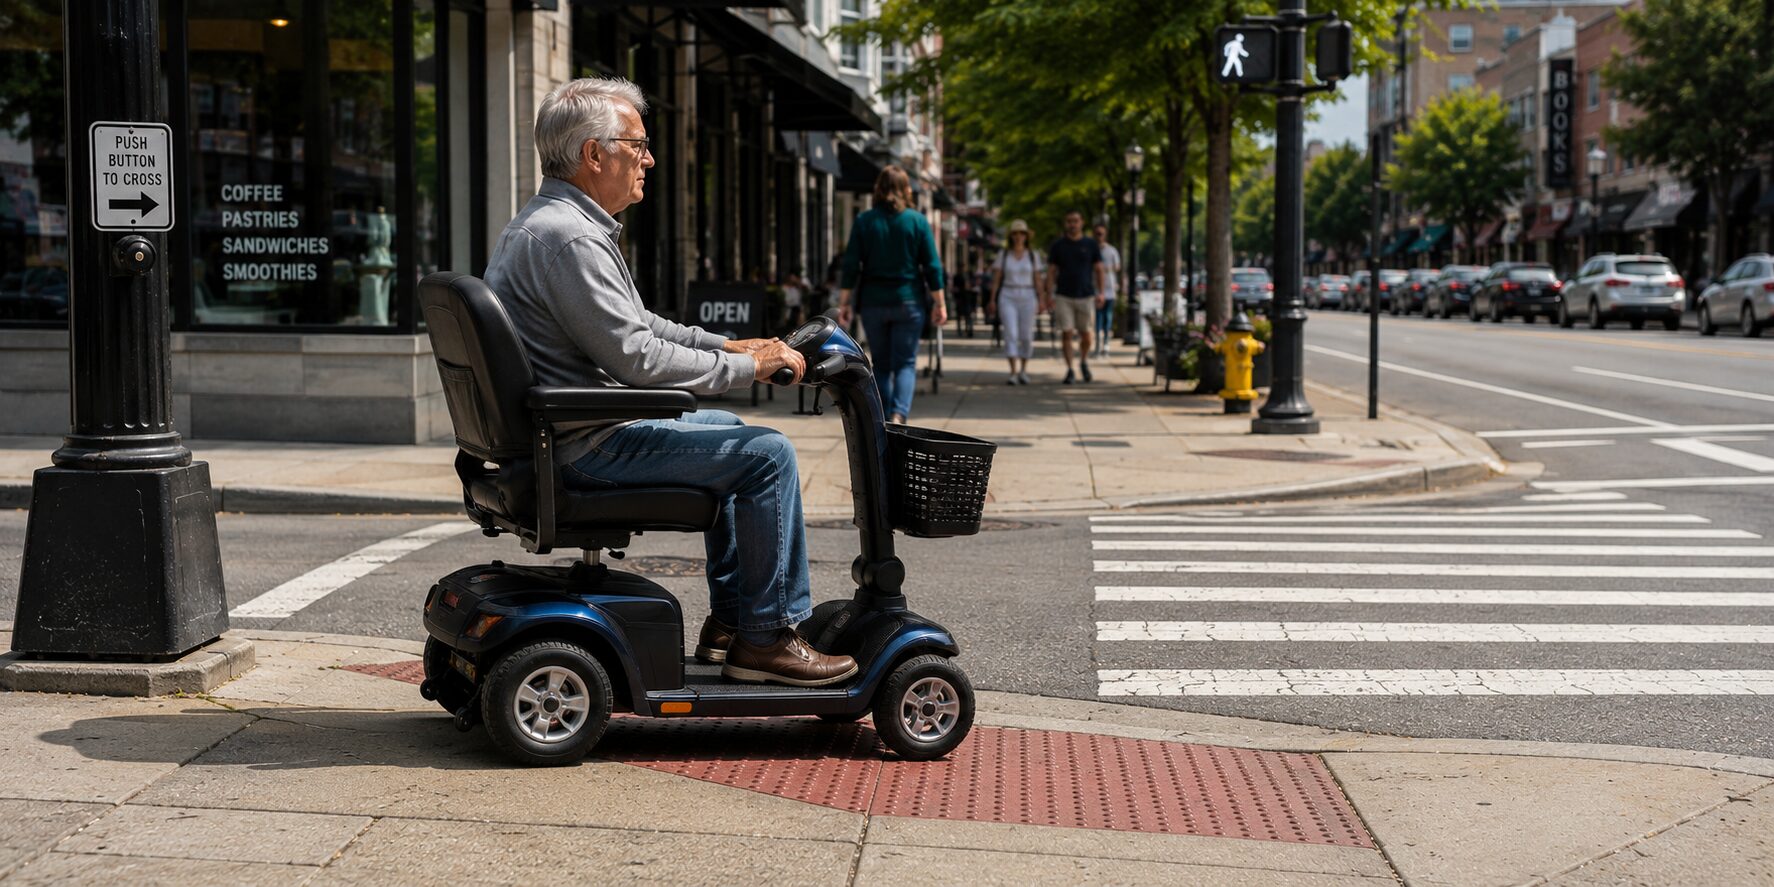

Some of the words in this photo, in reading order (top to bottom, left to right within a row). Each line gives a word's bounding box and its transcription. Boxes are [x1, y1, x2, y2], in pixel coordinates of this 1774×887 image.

[1553, 71, 1569, 173] BOOKS
[115, 135, 147, 150] PUSH
[108, 154, 156, 168] BUTTON
[103, 172, 118, 186] TO
[123, 172, 162, 186] CROSS
[221, 184, 283, 202] COFFEE
[222, 211, 299, 228] PASTRIES
[222, 237, 329, 254] SANDWICHES
[223, 263, 318, 281] SMOOTHIES
[700, 301, 750, 323] OPEN
